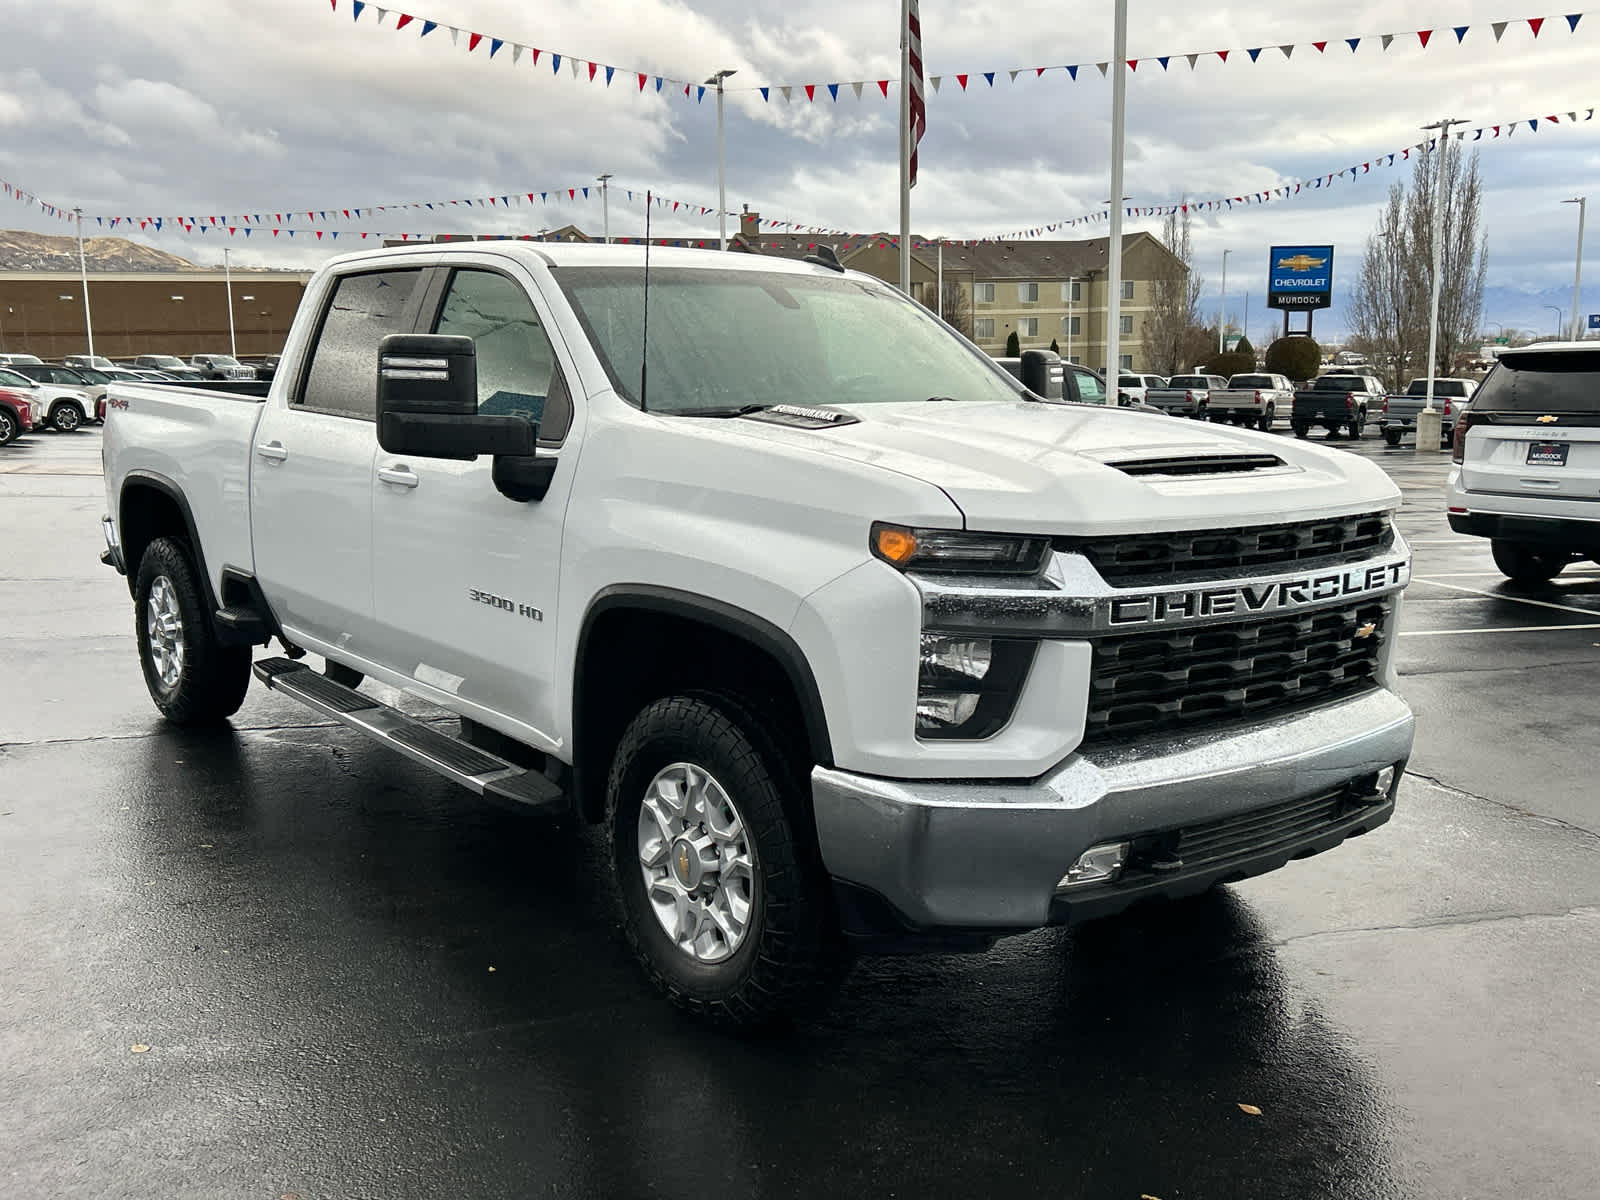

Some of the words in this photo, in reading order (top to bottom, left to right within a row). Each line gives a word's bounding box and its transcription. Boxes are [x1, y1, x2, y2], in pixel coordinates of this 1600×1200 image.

[1274, 278, 1327, 287] CHEVROLET
[1278, 296, 1321, 304] MURDOCK
[1109, 561, 1406, 625] CHEVROLET
[469, 588, 515, 612] 3500
[519, 603, 544, 622] HD
